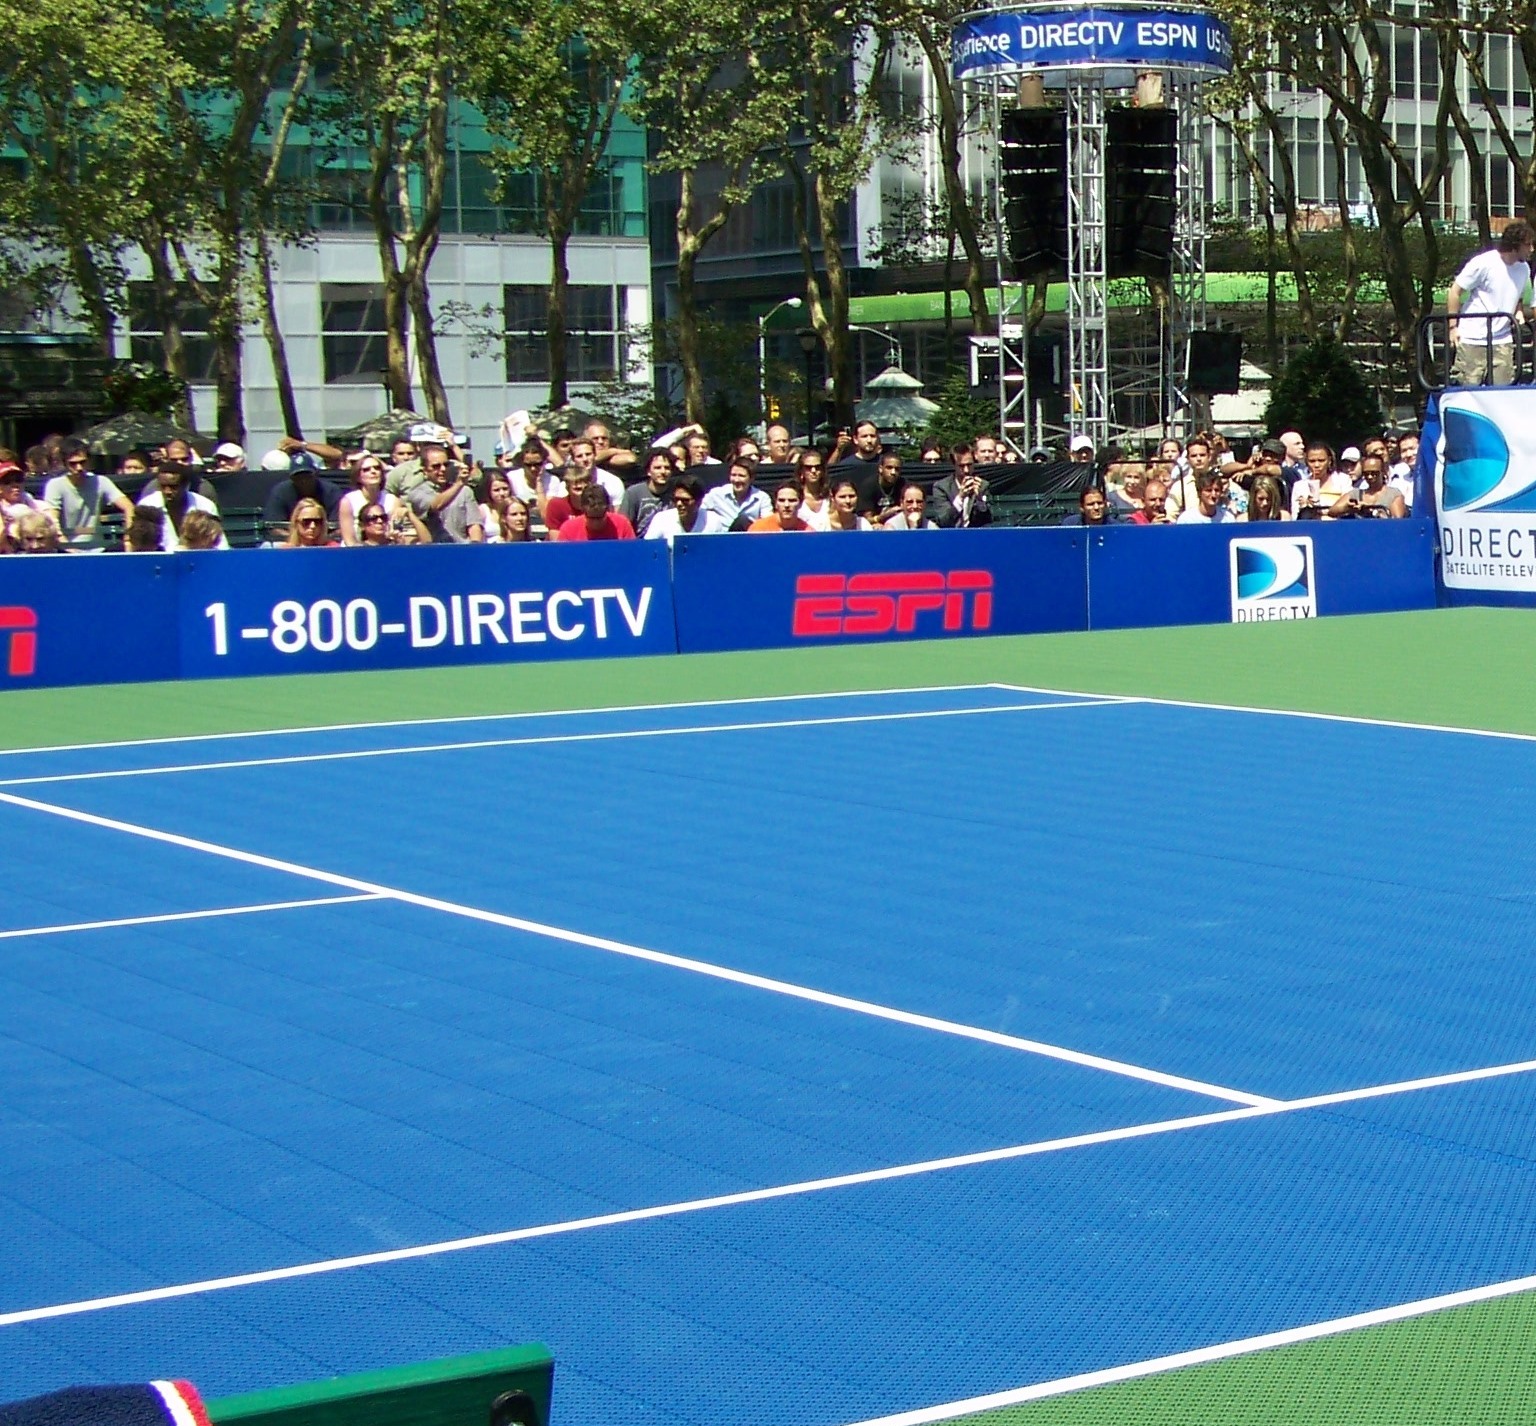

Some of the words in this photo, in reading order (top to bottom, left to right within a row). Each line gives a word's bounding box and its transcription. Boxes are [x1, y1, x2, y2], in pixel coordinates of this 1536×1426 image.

[1021, 21, 1124, 49] DIRECTV
[1138, 22, 1197, 49] ESPN
[1206, 27, 1221, 53] US
[1445, 561, 1495, 577] SATELLITE
[793, 570, 995, 637] ESPN
[1237, 606, 1310, 622] DIRECTV
[205, 586, 653, 656] 1-800-DIRECTV
